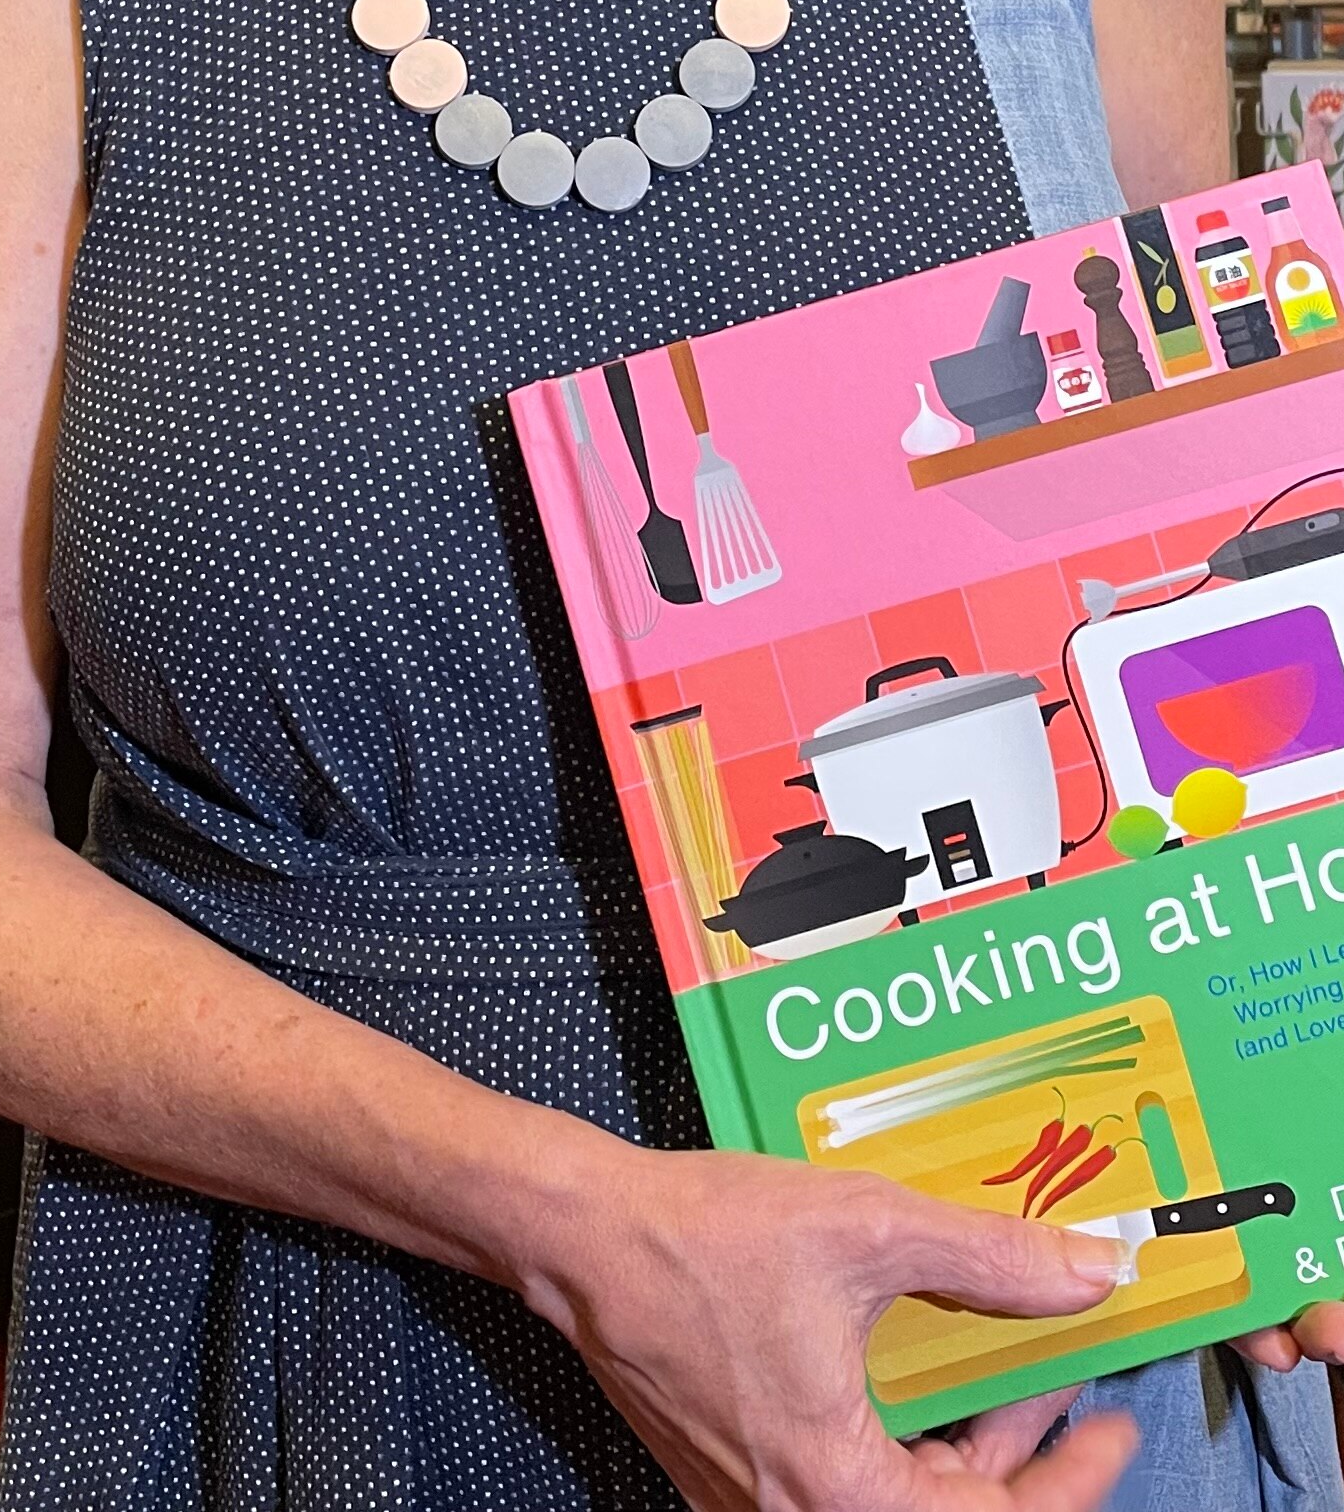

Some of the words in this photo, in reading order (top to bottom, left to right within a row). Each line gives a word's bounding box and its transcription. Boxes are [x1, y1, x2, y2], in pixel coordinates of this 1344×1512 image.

[766, 916, 1121, 1060] Cooking
[1145, 873, 1232, 954] at
[1208, 975, 1245, 996] Or,
[1249, 956, 1303, 986] How
[1309, 948, 1317, 969] I
[1233, 980, 1344, 1024] Worrying
[1235, 1026, 1289, 1061] (and
[1294, 1246, 1331, 1285] &
